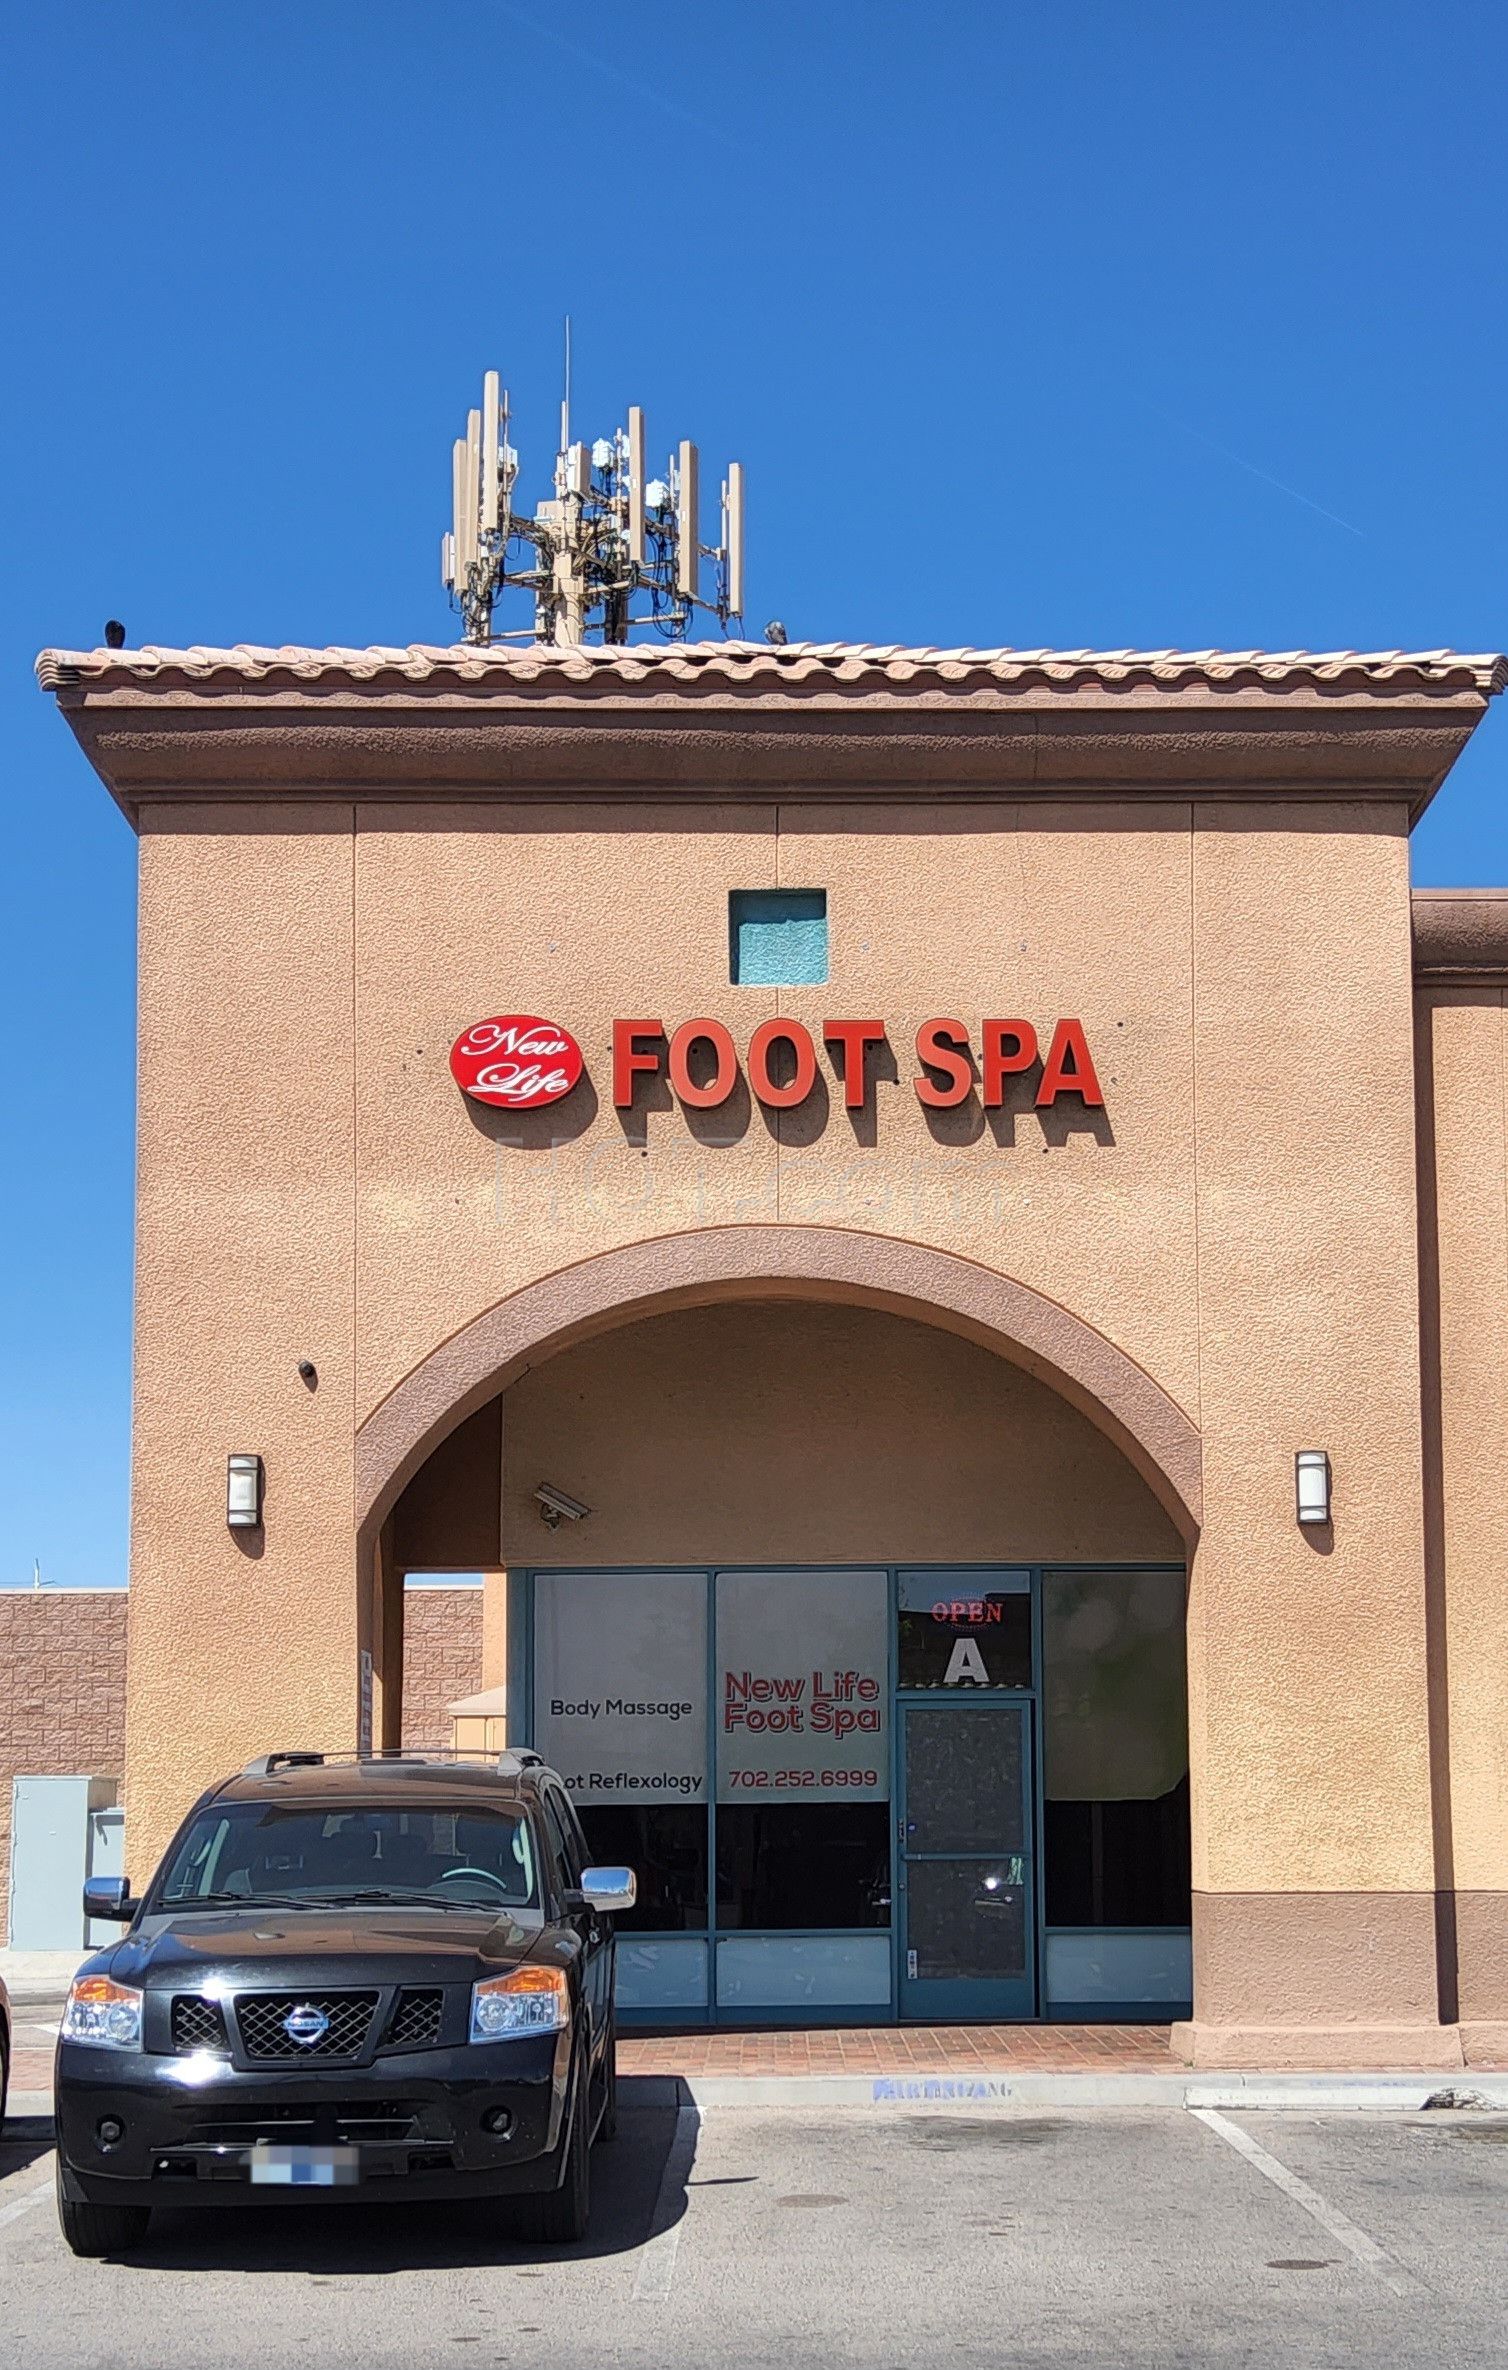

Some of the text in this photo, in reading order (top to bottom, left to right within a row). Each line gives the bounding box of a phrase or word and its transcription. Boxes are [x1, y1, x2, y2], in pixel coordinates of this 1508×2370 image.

[460, 1023, 570, 1056] New
[612, 1017, 1105, 1108] FOOT SPA
[466, 1062, 570, 1102] Life
[930, 1601, 1004, 1622] OPEN
[942, 1637, 991, 1684] A
[724, 1671, 880, 1702] New Life
[550, 1699, 693, 1721] Body Massage
[724, 1701, 881, 1740] Foot Spa
[564, 1772, 703, 1795] ot Reflexology
[728, 1769, 878, 1788] 702.252.6999
